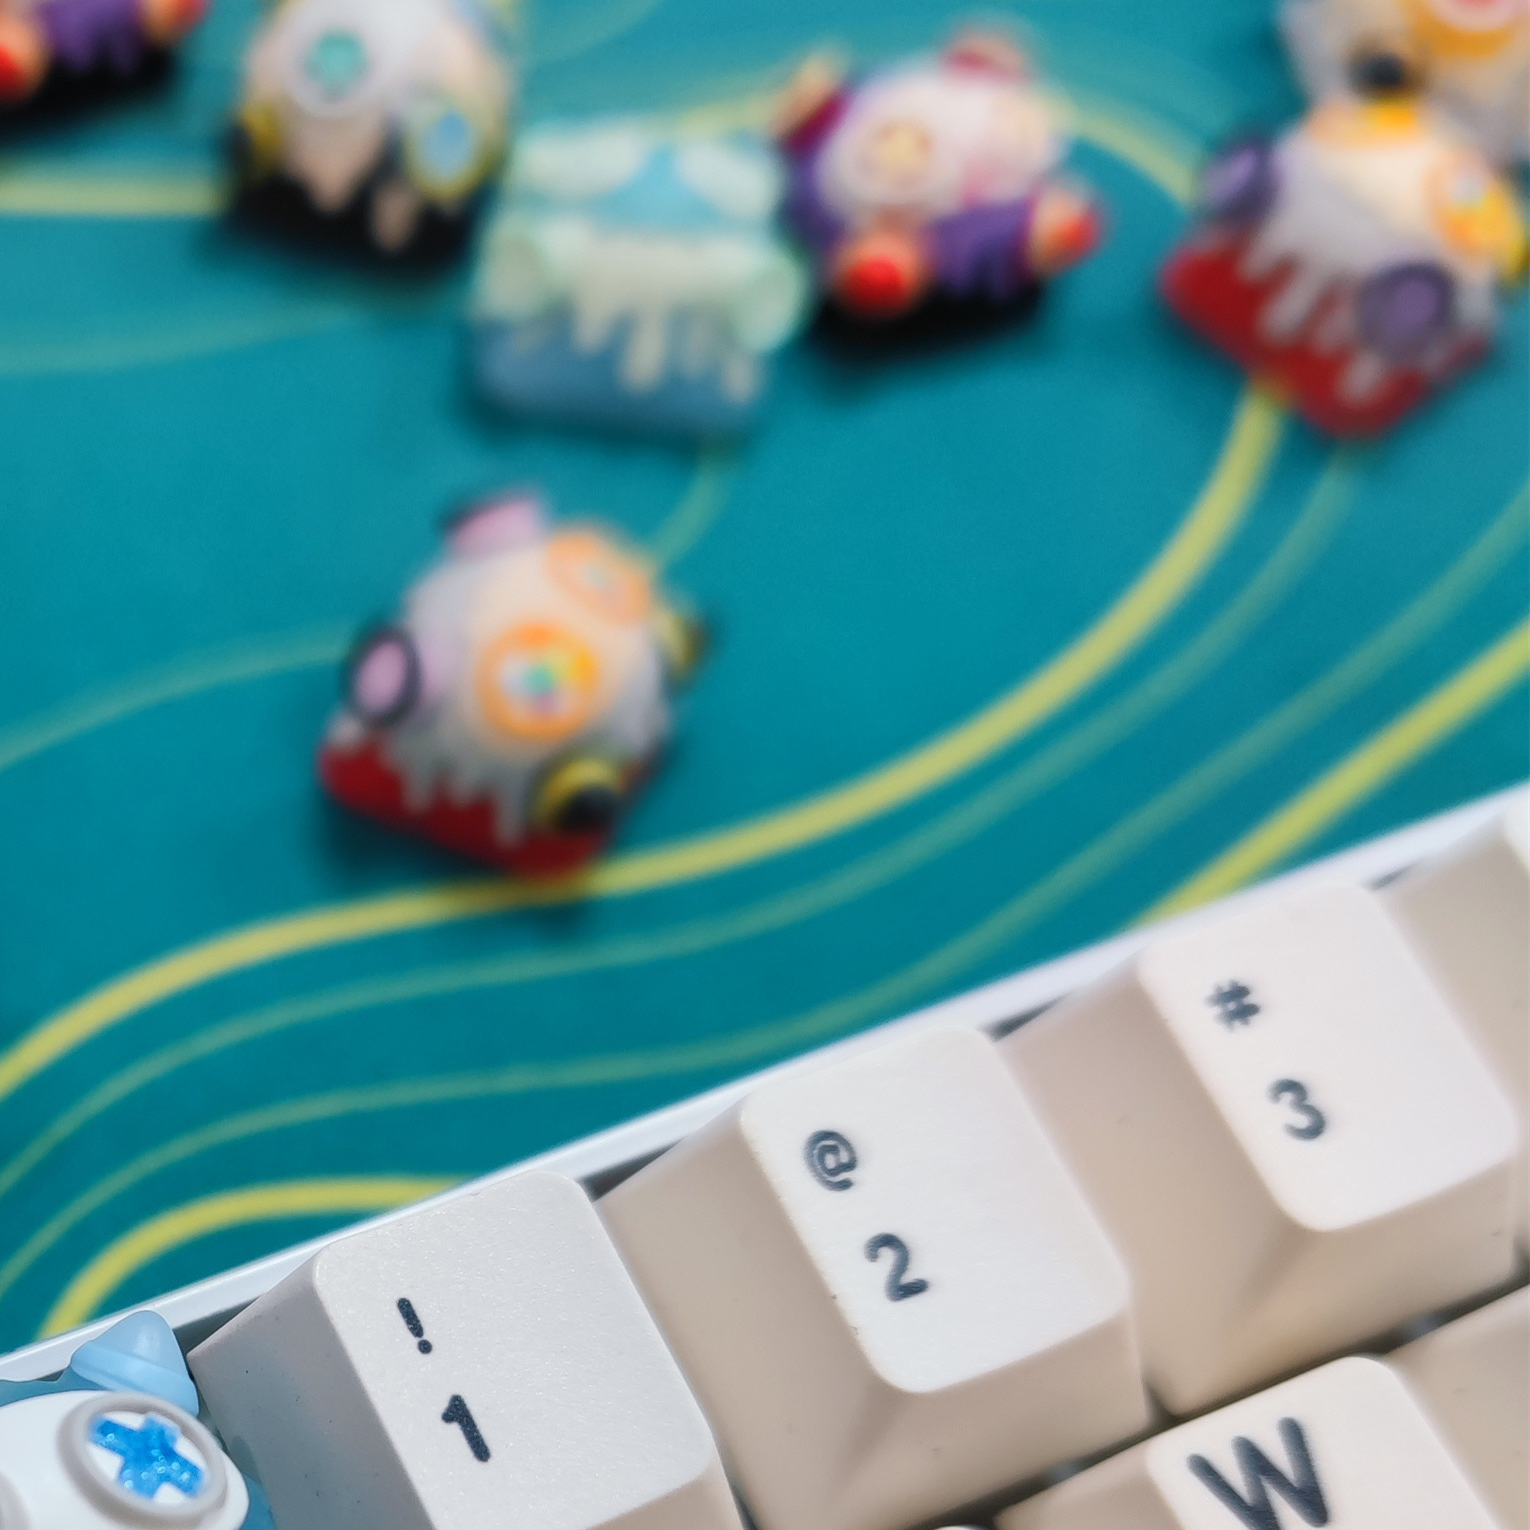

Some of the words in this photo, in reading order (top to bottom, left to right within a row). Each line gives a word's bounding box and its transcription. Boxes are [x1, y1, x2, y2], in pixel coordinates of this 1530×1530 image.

[1206, 979, 1261, 1029] #
[1269, 1078, 1327, 1141] 3
[805, 1129, 859, 1193] @
[865, 1232, 929, 1303] 2
[396, 1297, 433, 1355] !
[441, 1394, 491, 1463] 1
